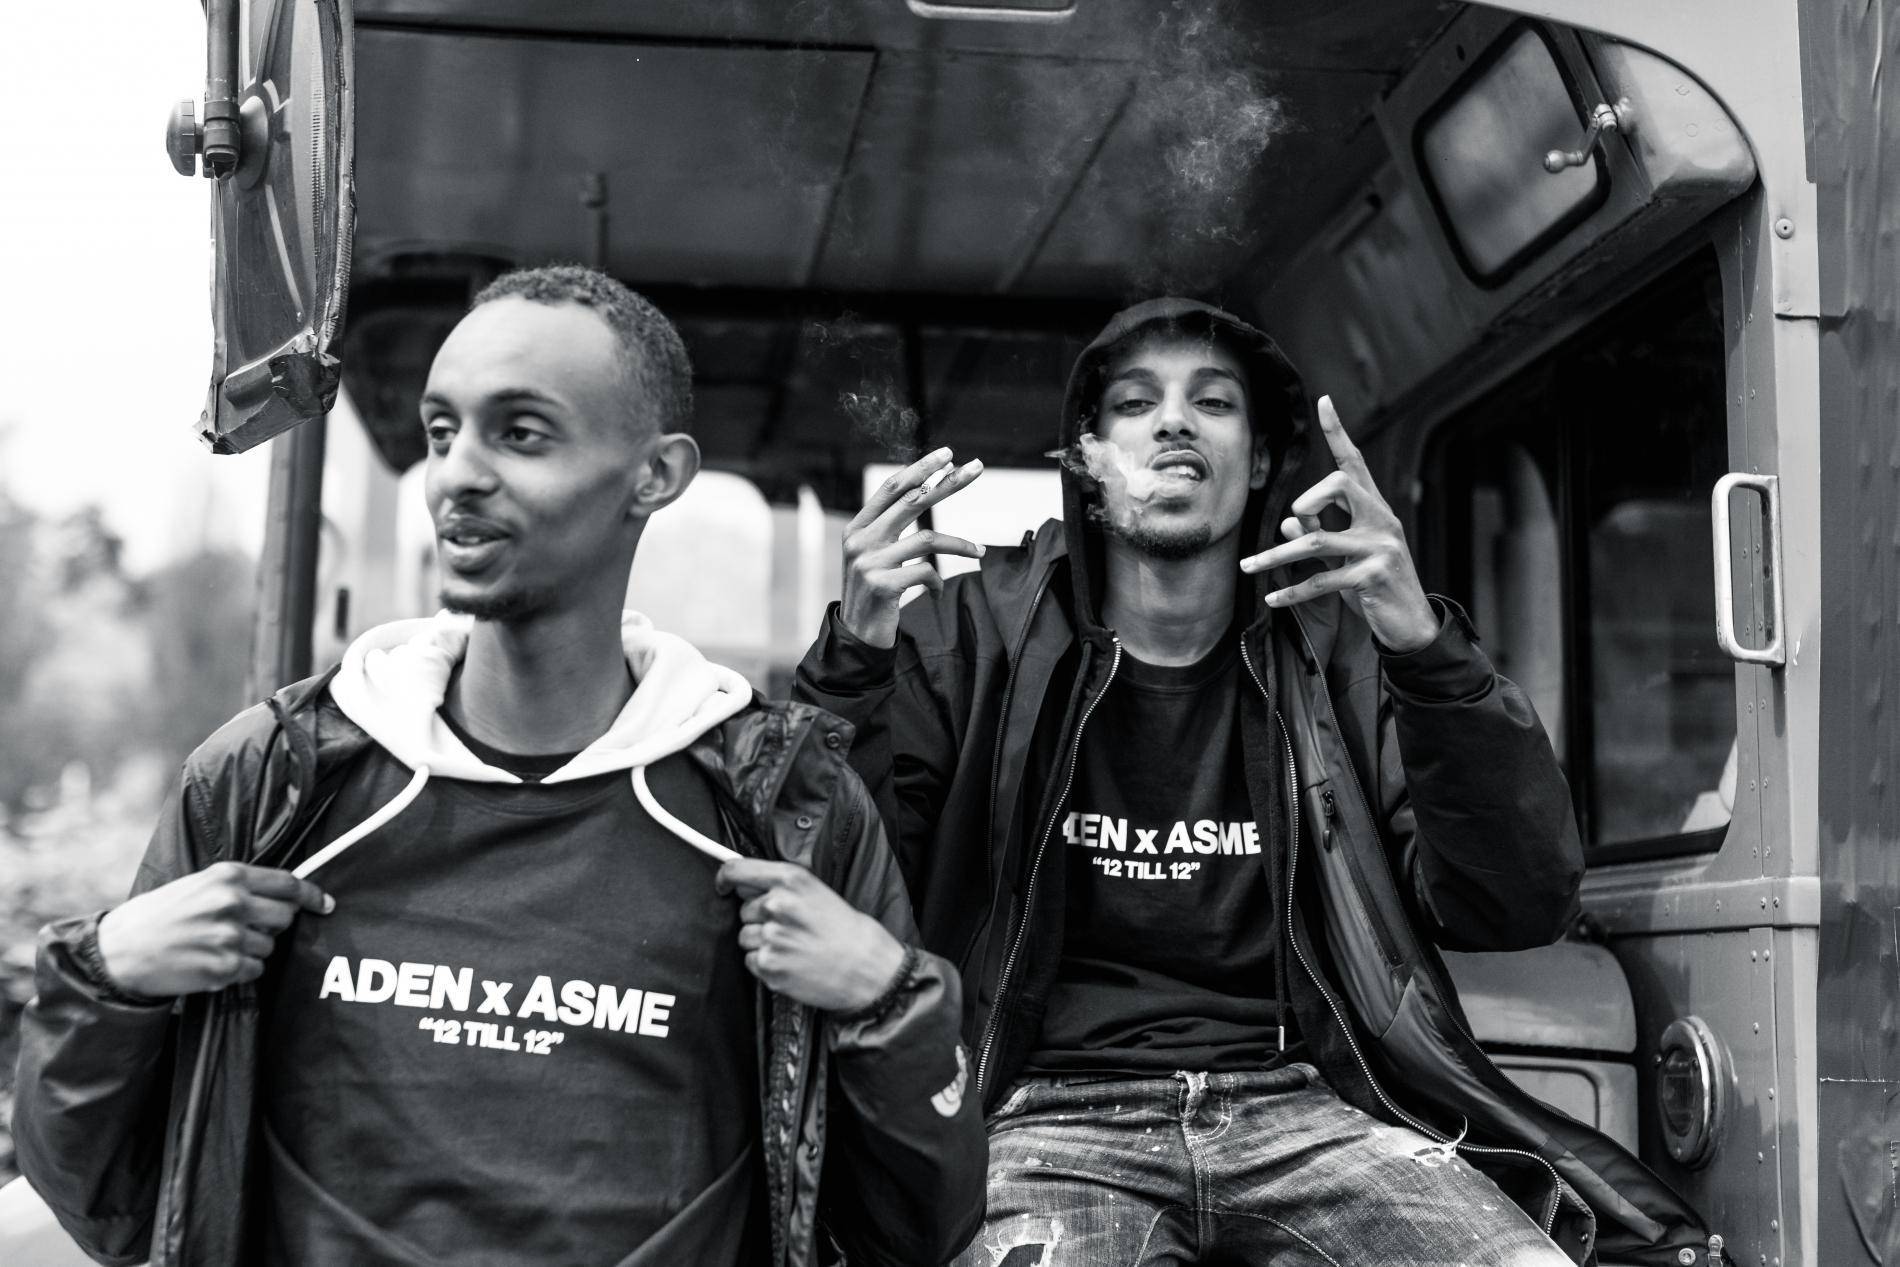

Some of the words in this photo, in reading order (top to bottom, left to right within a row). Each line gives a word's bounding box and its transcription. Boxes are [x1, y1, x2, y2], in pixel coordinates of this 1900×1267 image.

[1133, 828, 1159, 854] x
[1163, 819, 1262, 856] ASME
[1124, 860, 1168, 880] TILL
[319, 955, 474, 1012] ADEN
[476, 979, 514, 1017] x
[516, 974, 676, 1038] ASME
[462, 1020, 521, 1052] TILL
